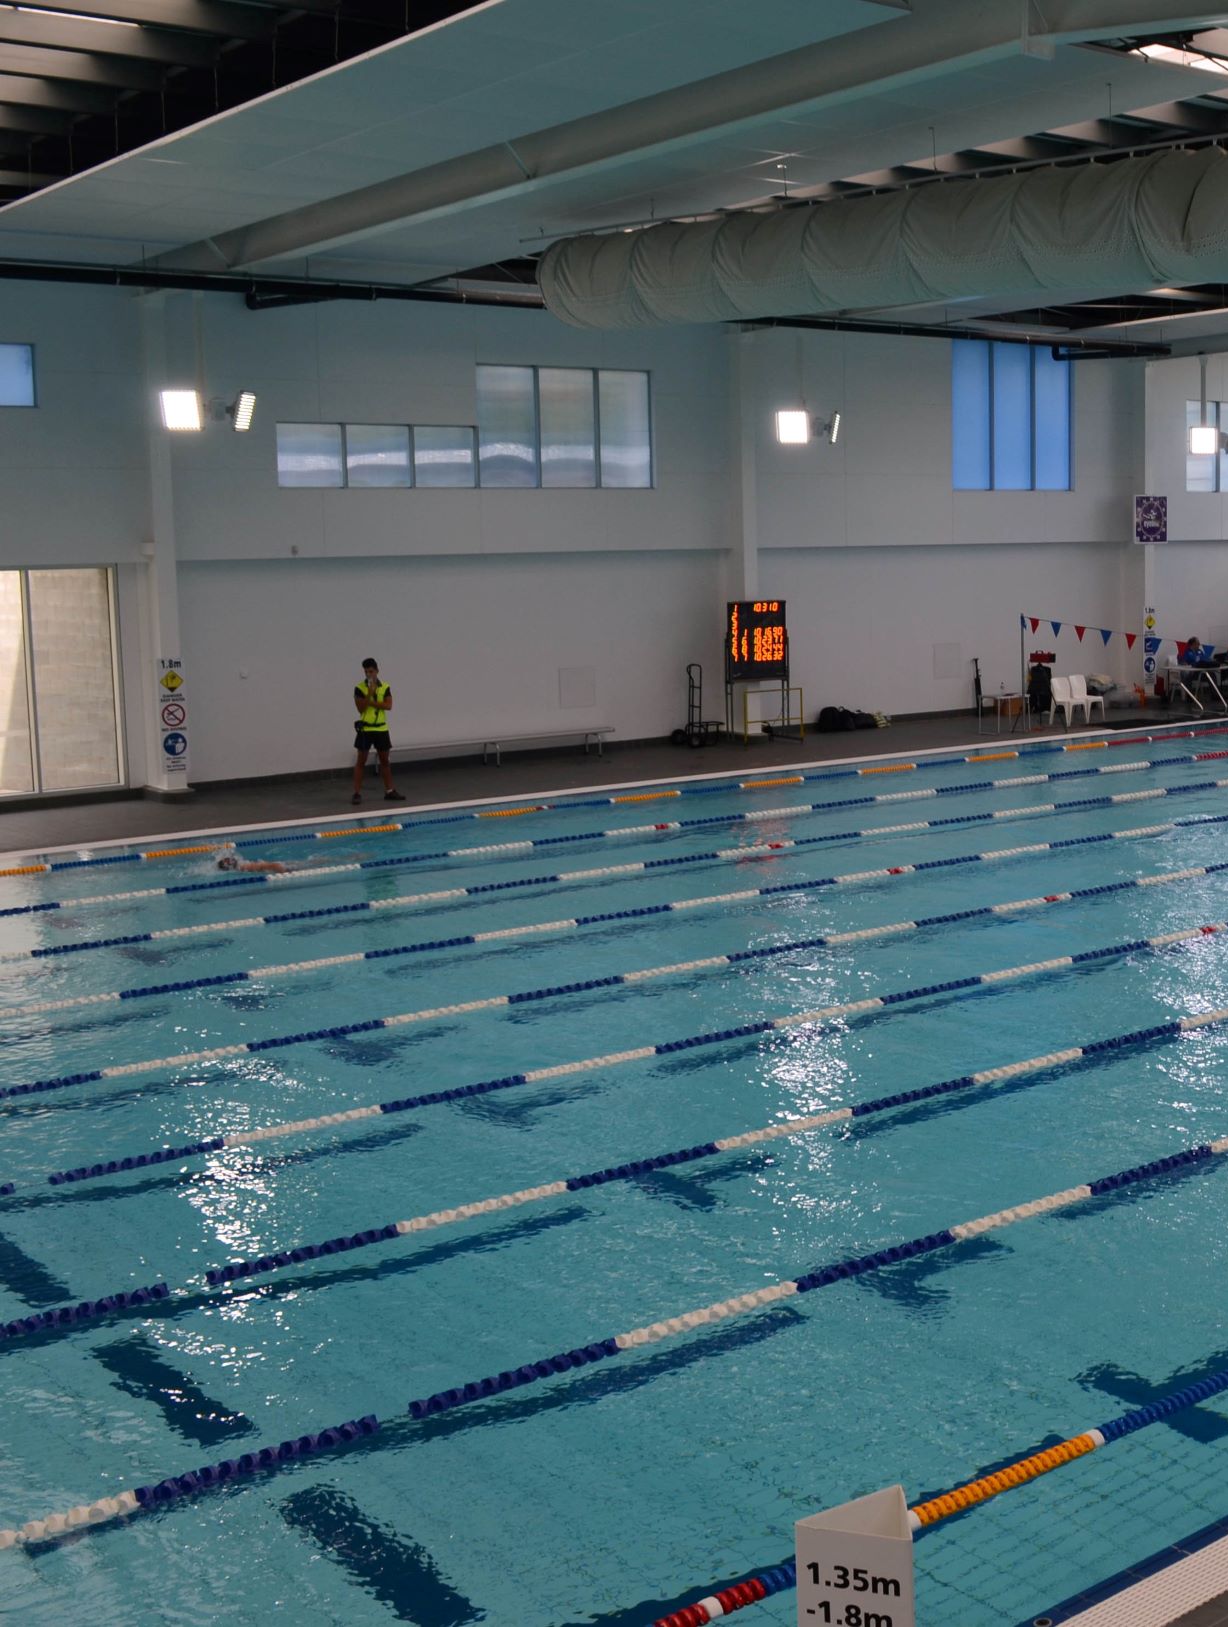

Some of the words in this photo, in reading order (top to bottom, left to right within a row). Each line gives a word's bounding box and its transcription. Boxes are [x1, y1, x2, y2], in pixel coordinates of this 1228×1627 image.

[161, 659, 181, 669] 1.8m
[806, 1562, 901, 1597] 1.35m
[806, 1600, 893, 1627] -1.8m
